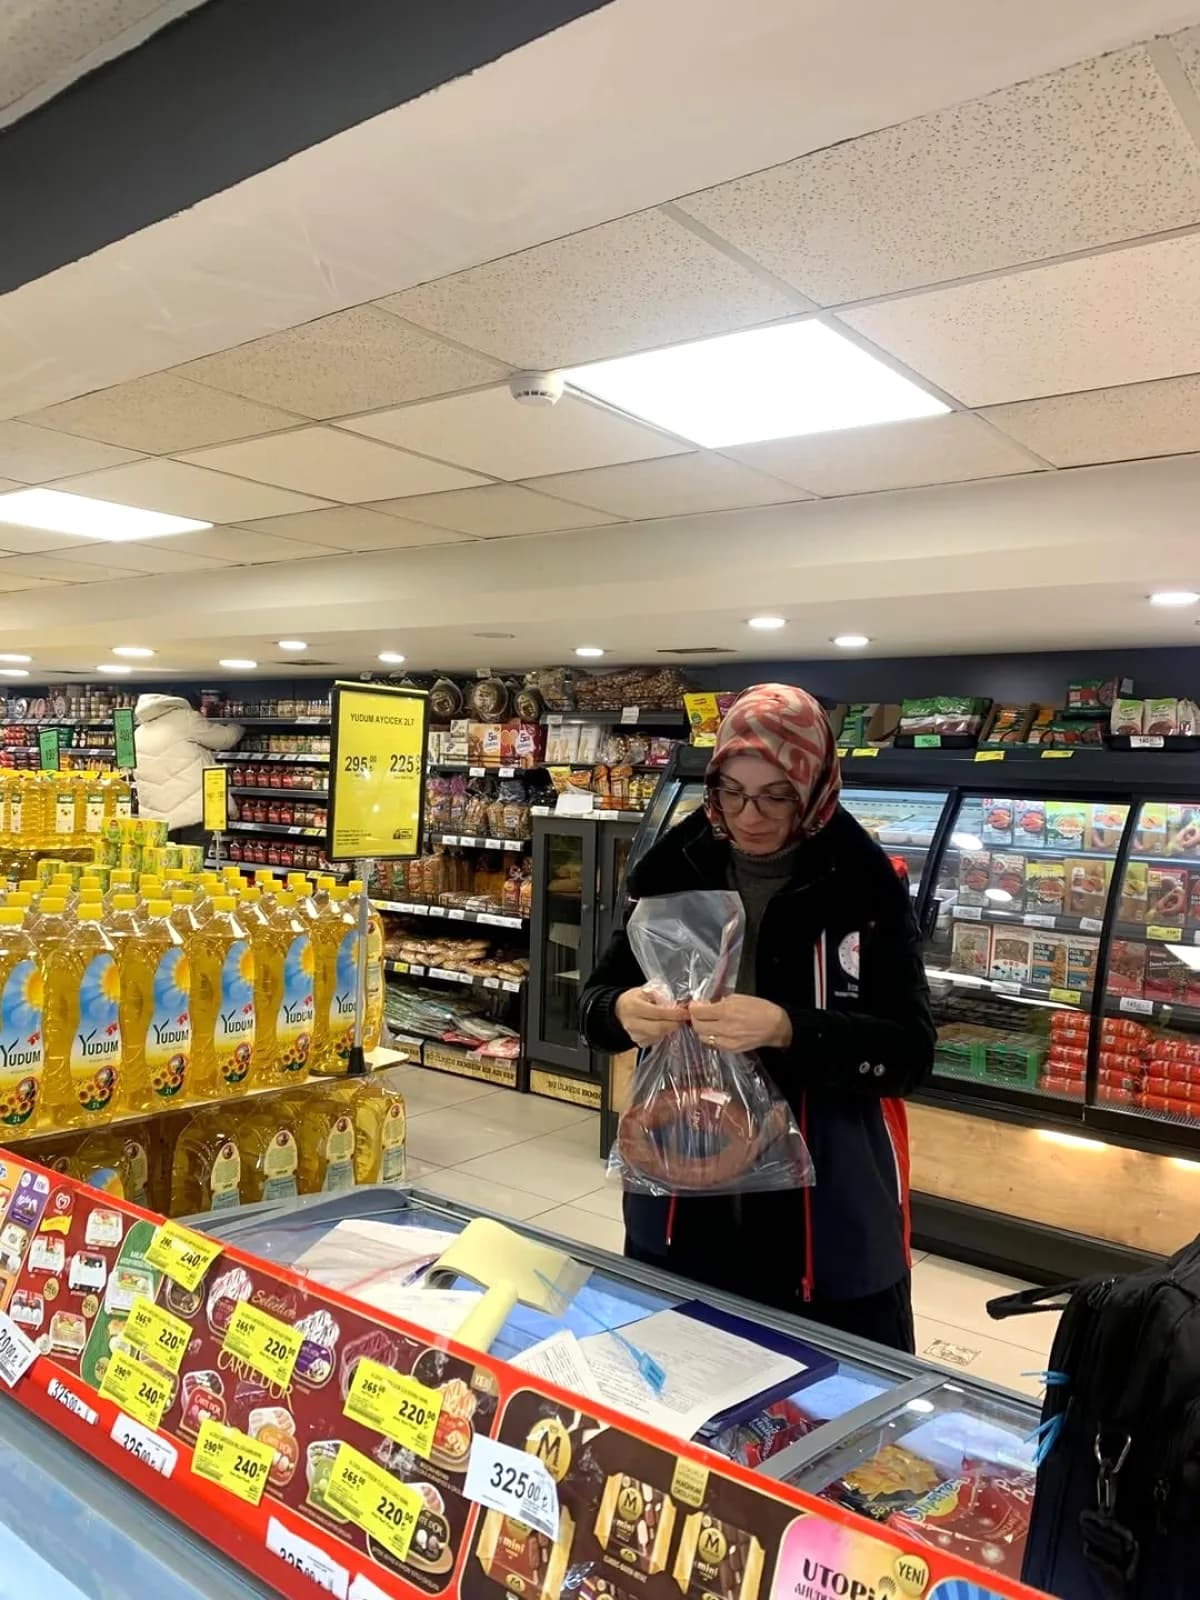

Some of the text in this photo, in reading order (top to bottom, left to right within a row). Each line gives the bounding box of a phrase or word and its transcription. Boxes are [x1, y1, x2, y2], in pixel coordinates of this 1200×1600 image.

[350, 713, 374, 723] YUDUM
[345, 756, 368, 772] 295
[390, 754, 414, 773] 225
[220, 1009, 253, 1034] YUDUM
[283, 1000, 313, 1024] YUDUM
[78, 1027, 119, 1056] YUDUM
[153, 1018, 189, 1045] YUDUM
[0, 1037, 41, 1067] YUDUM
[159, 1329, 178, 1350] 220
[264, 1338, 287, 1360] 220
[138, 1383, 158, 1404] 240
[361, 1379, 378, 1394] 265
[398, 1400, 425, 1425] 220
[234, 1455, 258, 1478] 240
[342, 1467, 358, 1485] 265
[490, 1462, 529, 1499] 325
[376, 1496, 403, 1526] 220
[616, 1519, 635, 1533] mini
[502, 1536, 526, 1552] mini
[697, 1561, 719, 1577] mini
[898, 1560, 926, 1587] YENİ
